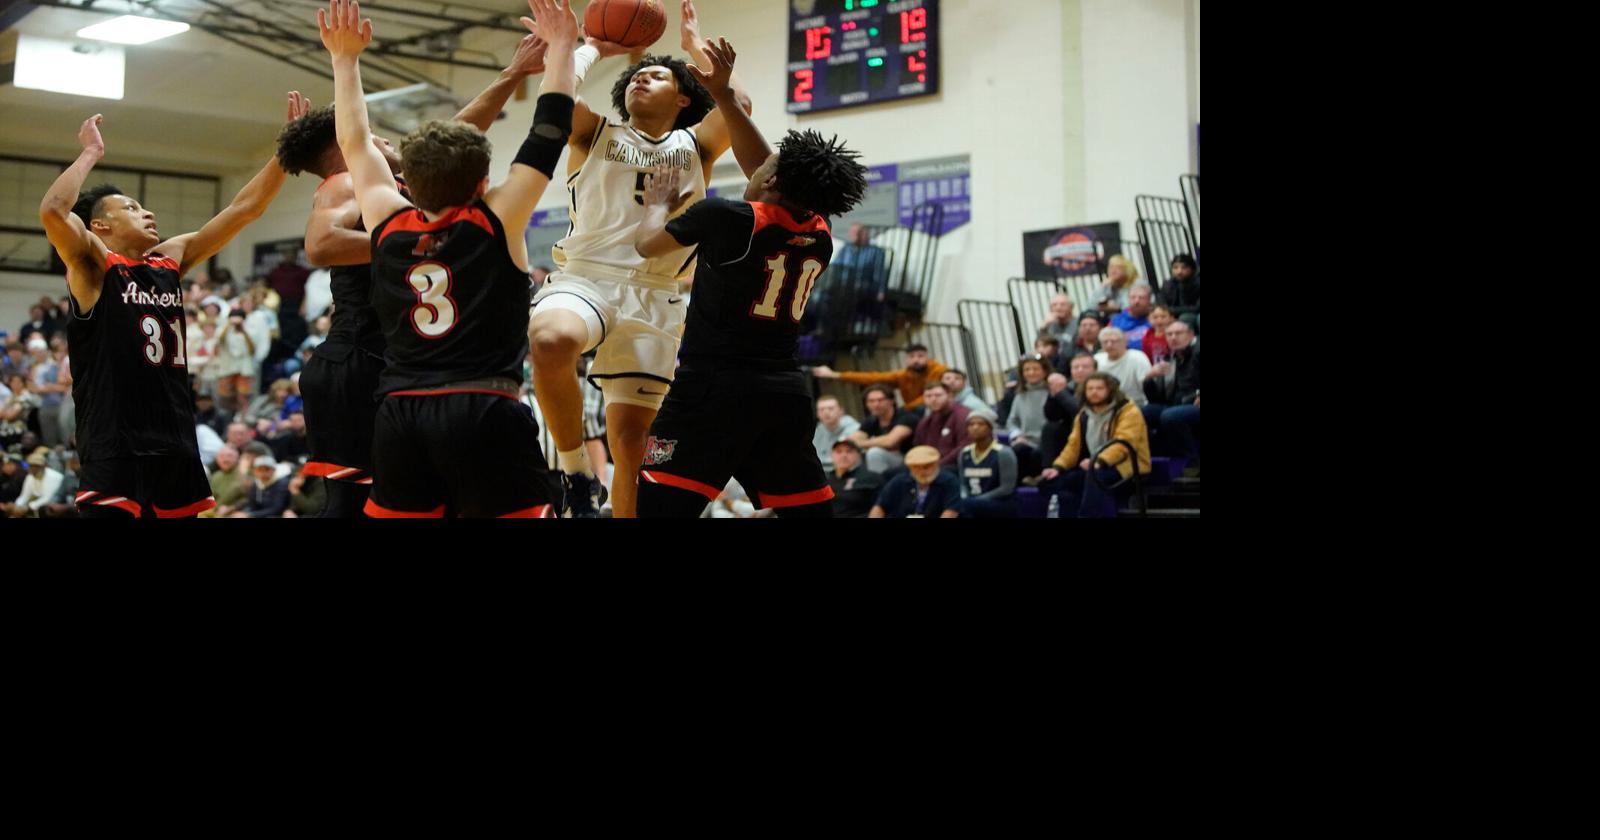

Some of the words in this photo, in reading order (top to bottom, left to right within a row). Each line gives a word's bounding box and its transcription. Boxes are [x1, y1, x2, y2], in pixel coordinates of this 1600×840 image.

[793, 69, 813, 102] 2
[405, 260, 459, 339] 3
[750, 253, 822, 321] 10
[140, 314, 187, 367] 31
